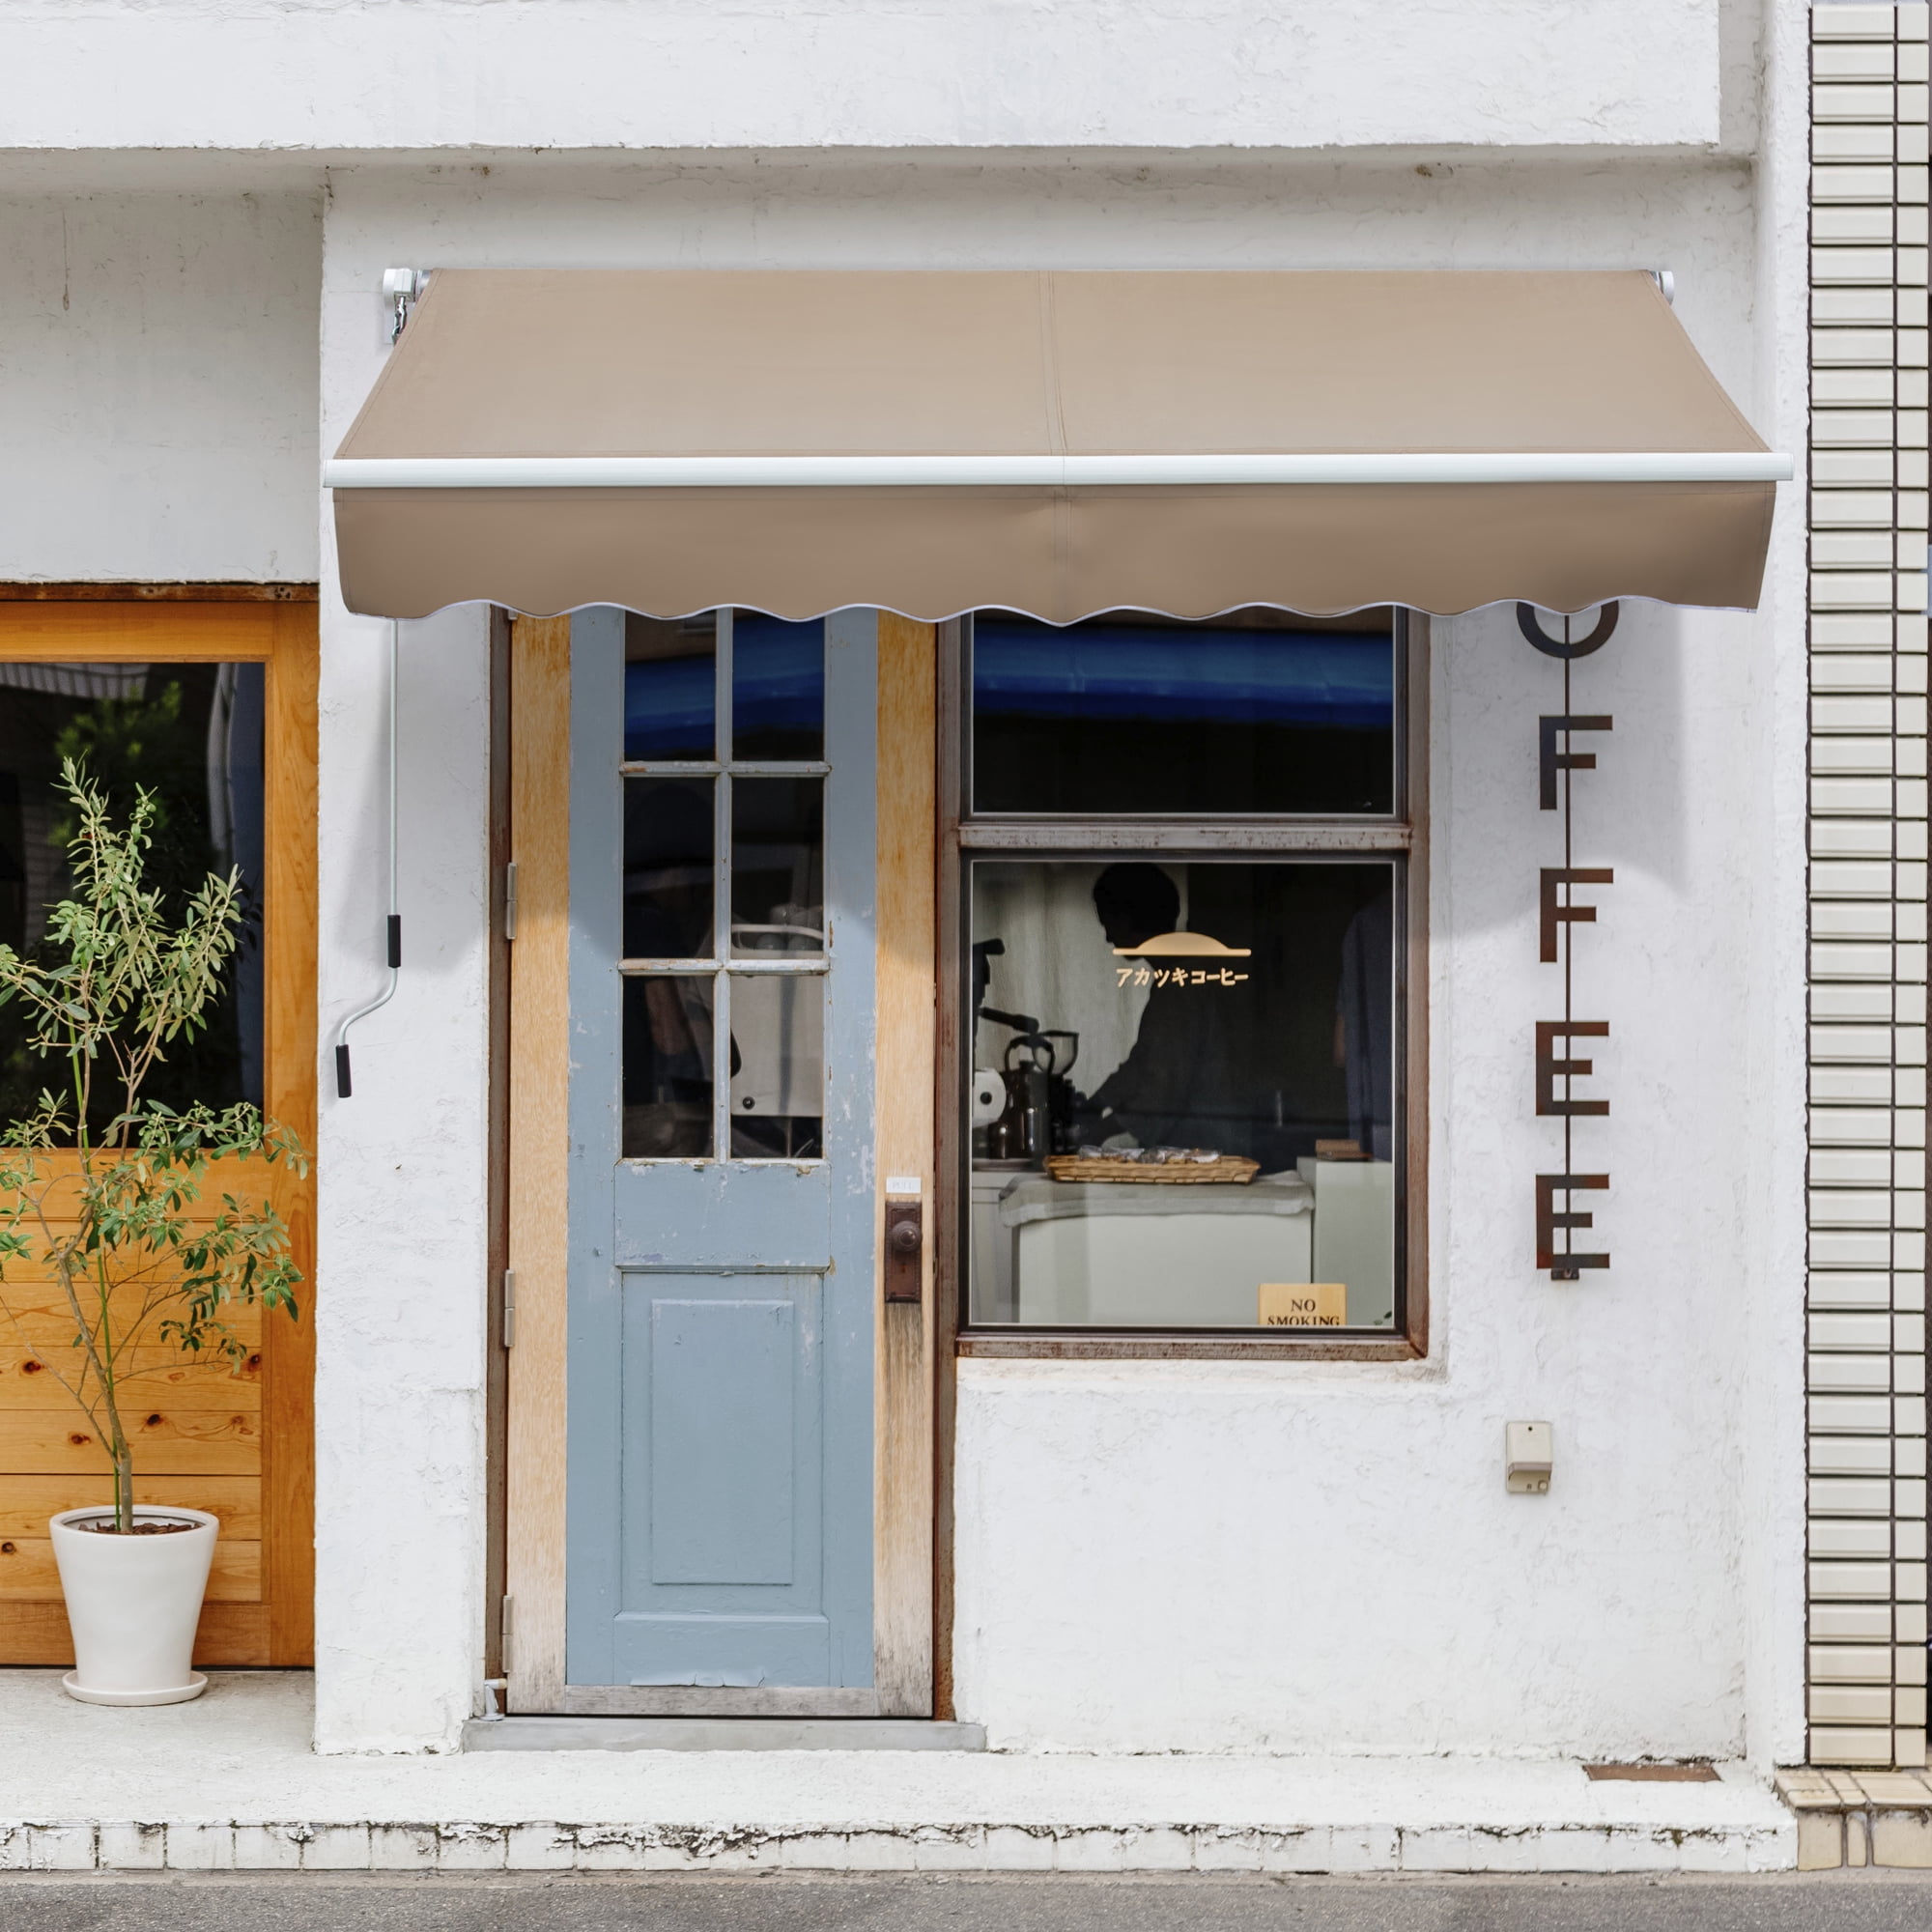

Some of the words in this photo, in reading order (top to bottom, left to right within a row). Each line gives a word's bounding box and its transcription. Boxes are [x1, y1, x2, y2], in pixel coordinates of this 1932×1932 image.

[1116, 967, 1249, 988] アカツキコーヒー
[1291, 1298, 1316, 1313] NO
[1266, 1316, 1340, 1326] SMOKING
